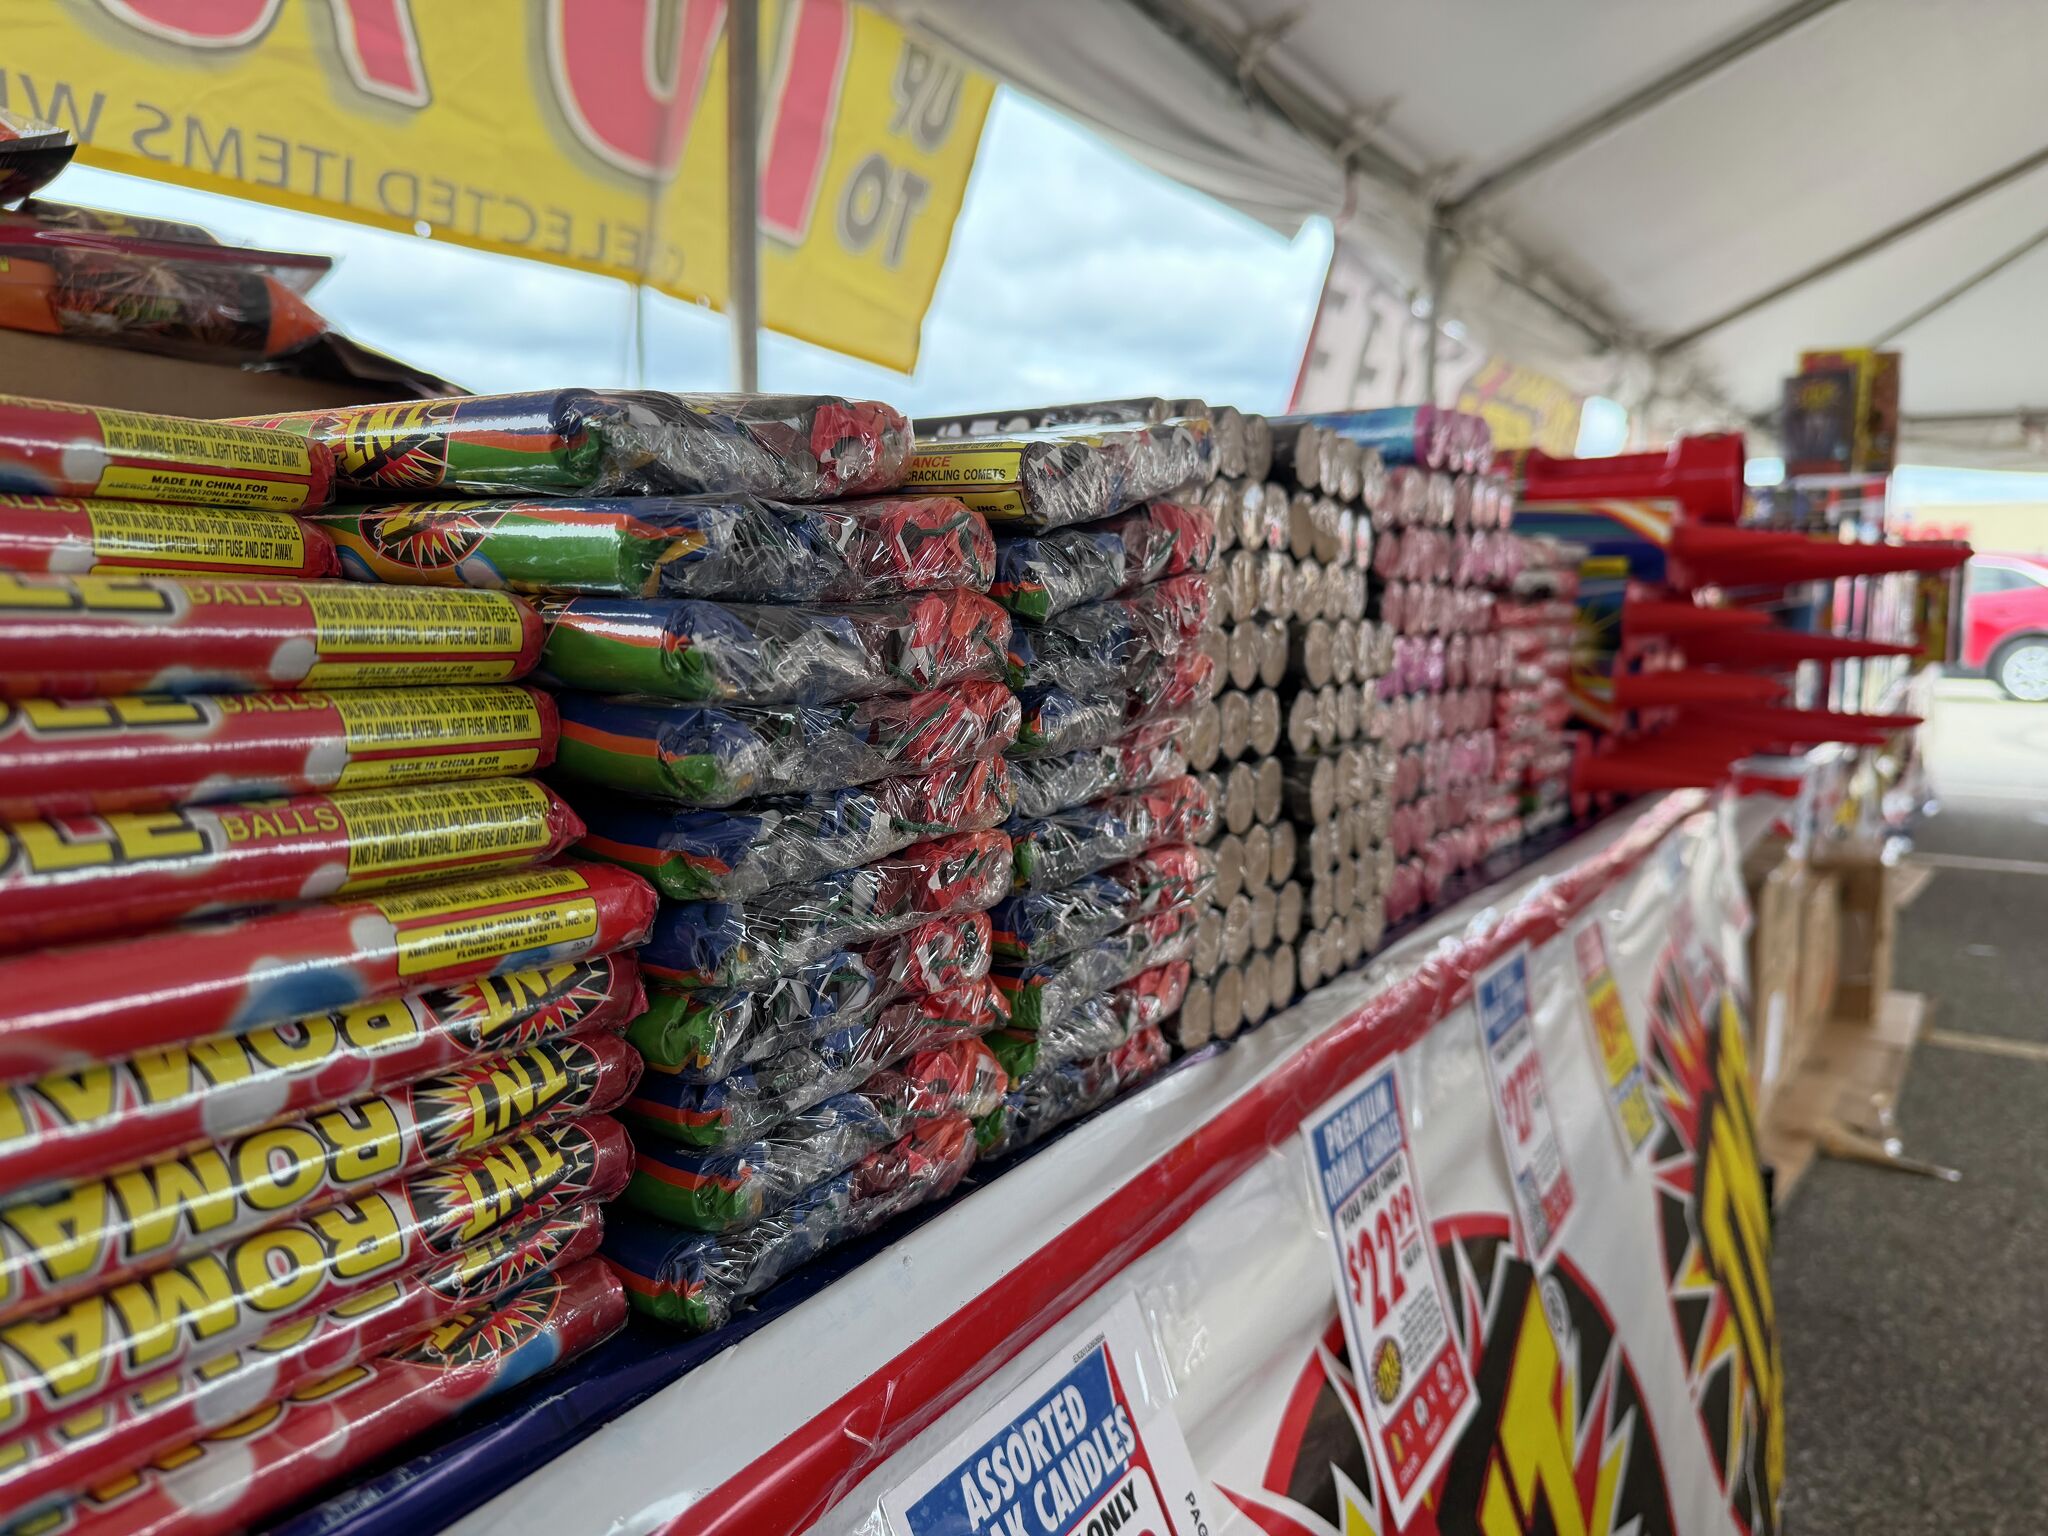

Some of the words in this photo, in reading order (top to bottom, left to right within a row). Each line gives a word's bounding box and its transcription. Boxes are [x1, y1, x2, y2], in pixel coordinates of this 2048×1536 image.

[906, 468, 960, 482] CRACKLING
[963, 468, 1006, 481] COMETS
[911, 455, 952, 469] ANCE
[151, 475, 187, 486] MADE
[190, 479, 203, 488] IN
[206, 480, 241, 490] CHINA
[245, 484, 268, 493] FOR
[101, 530, 115, 548] AND
[116, 531, 164, 551] FLAMMABLE
[165, 534, 203, 554] MATERIAL.
[204, 538, 224, 555] LIGHT
[226, 539, 243, 557] FUSE
[244, 541, 259, 558] AND
[260, 543, 273, 559] GET
[274, 544, 294, 561] AWAY.
[186, 584, 303, 606] BALLS
[357, 667, 392, 675] MADE
[412, 666, 447, 674] CHINA
[389, 764, 420, 774] MADE
[424, 762, 437, 770] IN
[440, 760, 475, 769] CHINA
[477, 756, 500, 766] FOR
[219, 808, 341, 843] BALLS
[351, 819, 386, 840] HALFWAY
[386, 818, 397, 837] IN
[398, 815, 418, 836] SAND
[418, 814, 431, 833] OR
[431, 812, 448, 832] SOIL
[448, 810, 464, 829] AND
[464, 808, 483, 827] POINT
[485, 806, 503, 824] AWAY
[503, 803, 524, 822] FROM
[522, 801, 548, 820] PEOPLE
[354, 844, 371, 867] AND
[371, 840, 417, 864] FLAMMABLE
[418, 836, 454, 858] MATERIAL.
[455, 832, 476, 852] LIGHT
[477, 829, 495, 849] FUSE
[496, 828, 510, 847] AND
[510, 826, 524, 845] GET
[524, 824, 542, 842] AWAY.
[407, 941, 457, 959] AMERICAN
[460, 927, 525, 947] PROMOTIONAL
[528, 921, 563, 935] EVENTS,
[566, 916, 582, 927] INC.
[457, 943, 506, 959] FLORENCE,
[510, 940, 520, 948] AL
[524, 934, 548, 945] 35630
[0, 999, 418, 1142] ROMA
[460, 1046, 569, 1151] TNT
[1323, 1080, 1391, 1161] PREMIUM
[0, 1098, 402, 1296] ROMA
[460, 1132, 565, 1242] TNT
[0, 1193, 403, 1415] ROMA
[960, 1384, 1087, 1532] ASSORTED
[1033, 1402, 1137, 1532] CANDLES
[1085, 1479, 1138, 1536] ONLY
